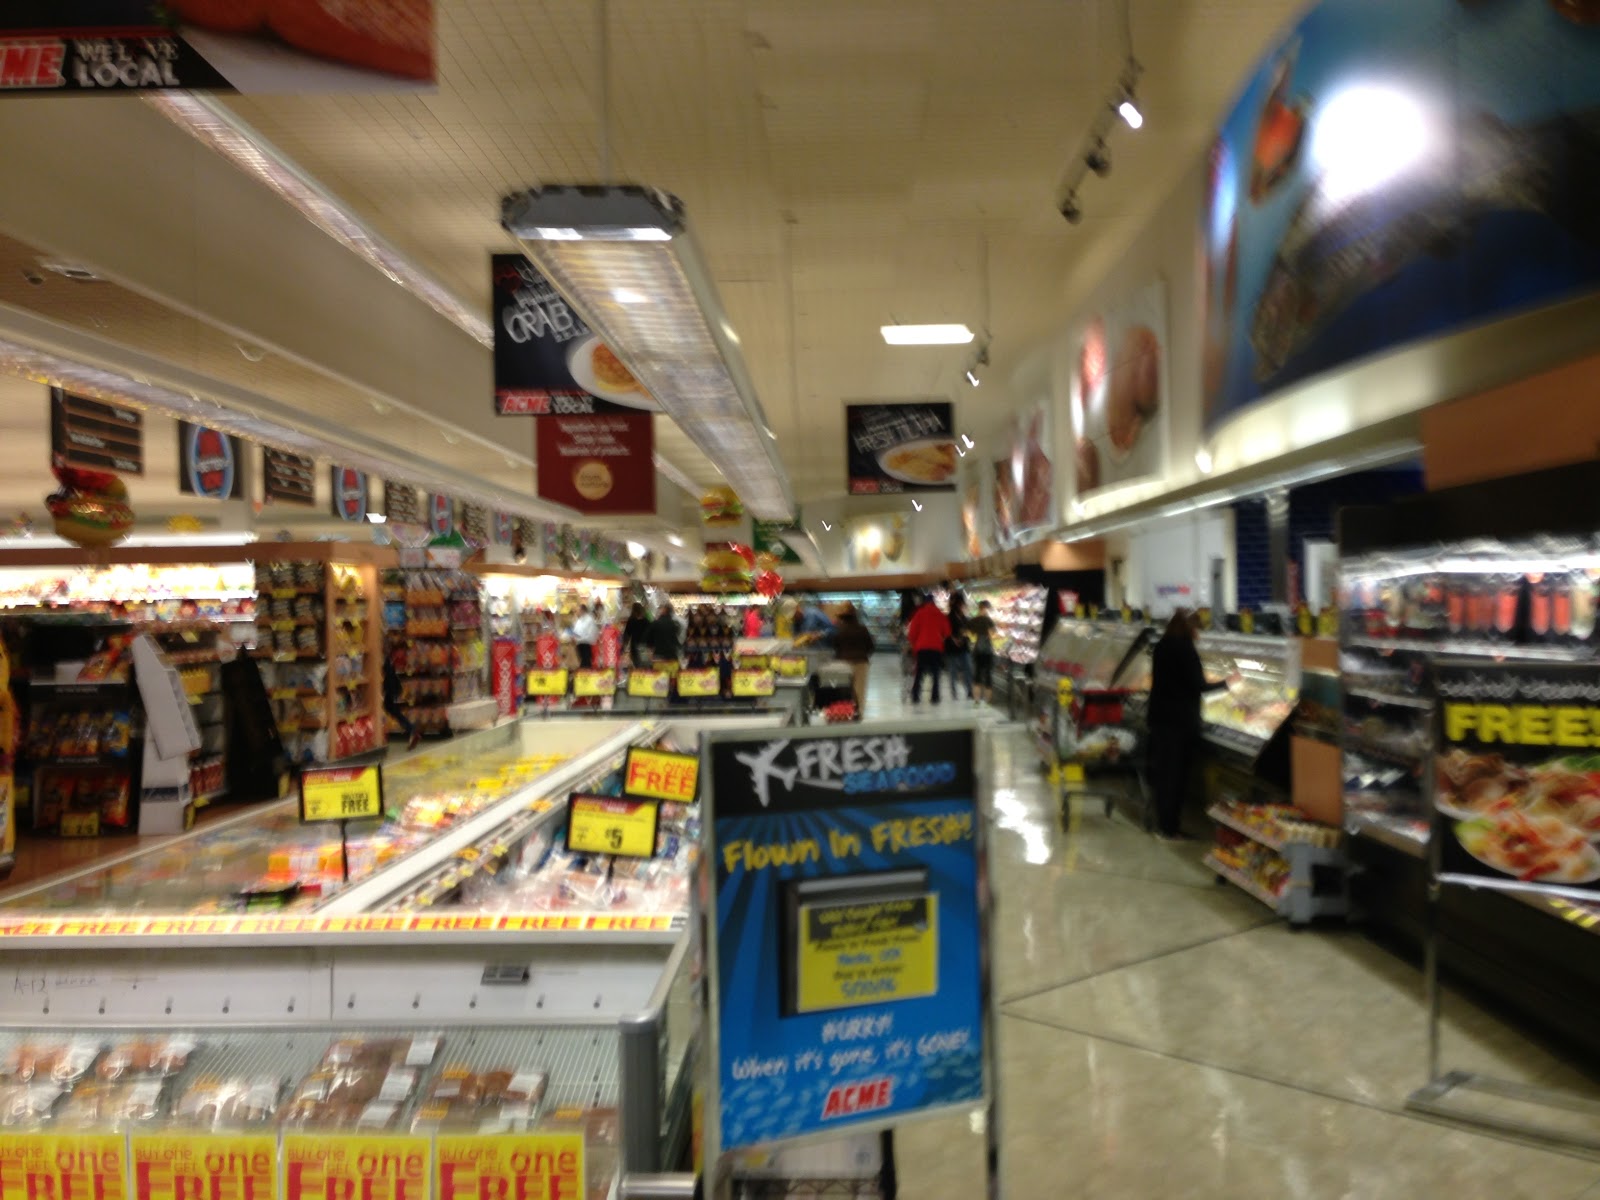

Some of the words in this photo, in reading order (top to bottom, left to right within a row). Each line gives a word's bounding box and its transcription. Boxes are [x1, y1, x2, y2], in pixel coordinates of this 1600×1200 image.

[76, 58, 180, 87] LOCAL
[796, 735, 911, 780] FRESH
[629, 763, 694, 797] FREE
[842, 762, 956, 793] SEAFOOD
[341, 800, 369, 814] FREE
[723, 839, 820, 872] Flown
[870, 811, 973, 853] FRESH!
[732, 1053, 789, 1081] When
[823, 1079, 893, 1117] ACME
[56, 1151, 119, 1172] one
[205, 1152, 270, 1175] one
[358, 1153, 423, 1177] one
[511, 1150, 577, 1173] one
[137, 1162, 271, 1200] FREE
[287, 1162, 423, 1200] FREE
[440, 1162, 577, 1200] FREE
